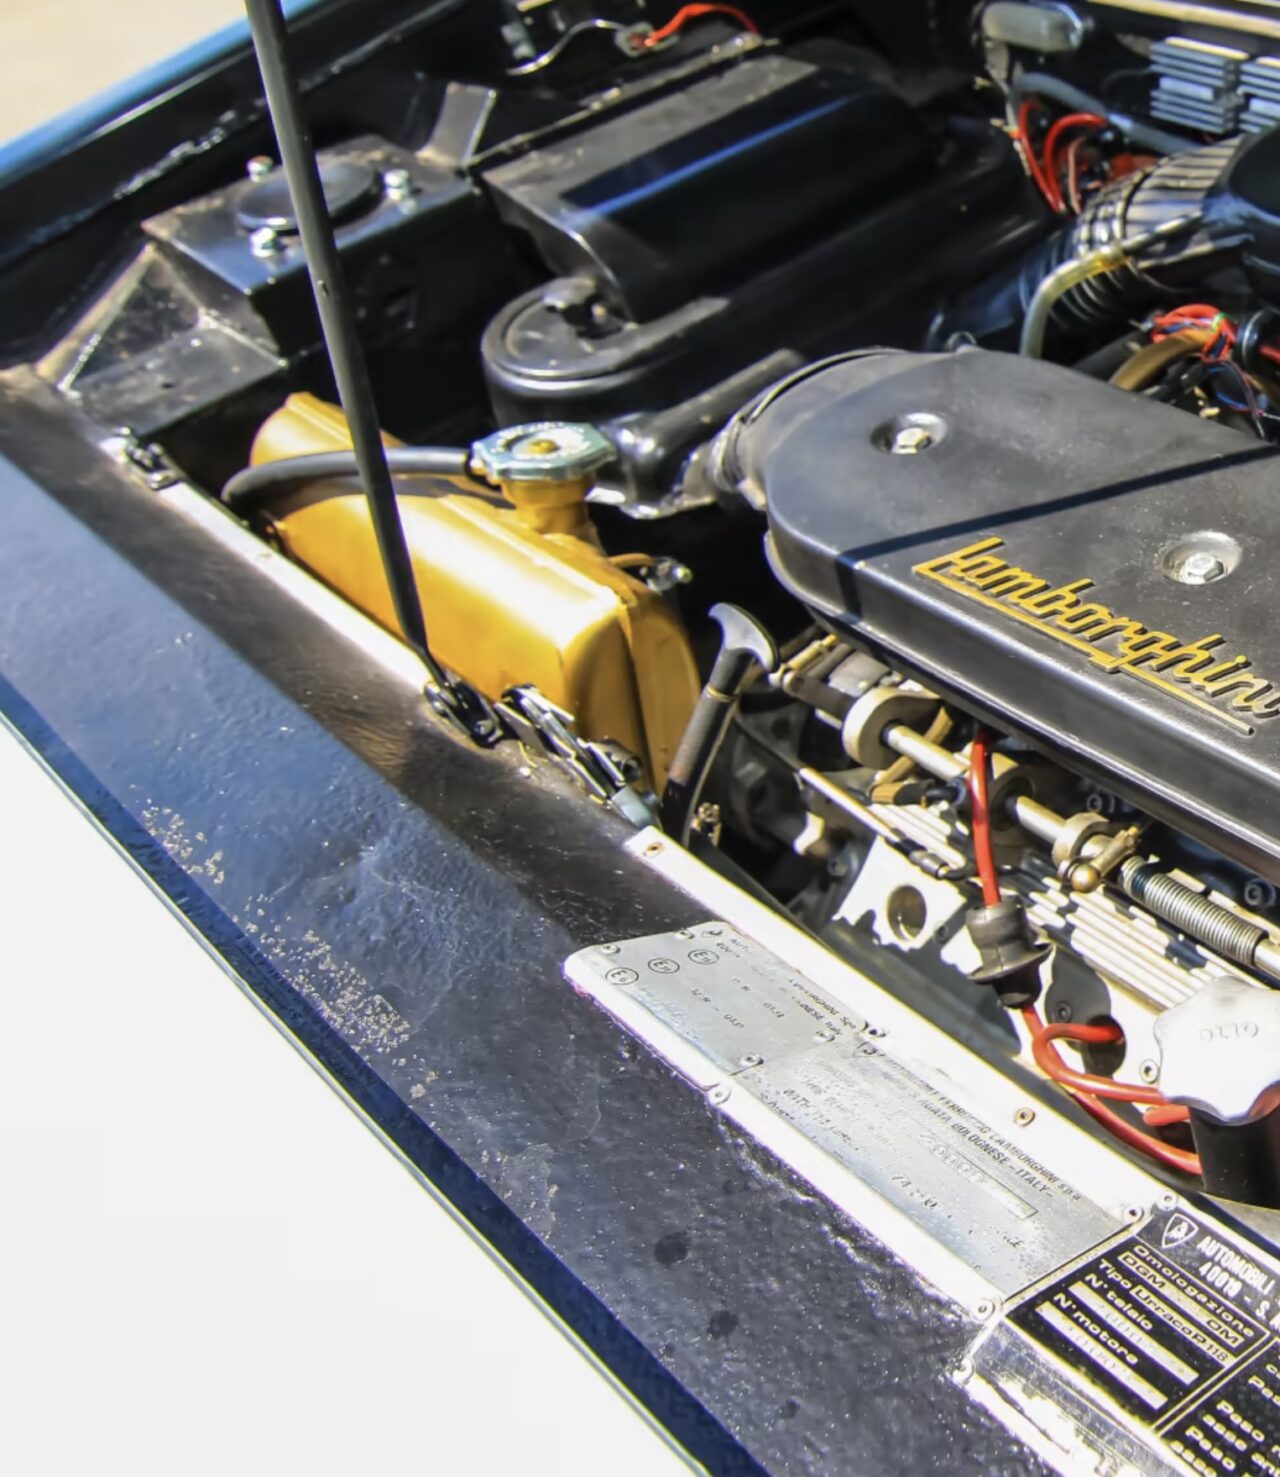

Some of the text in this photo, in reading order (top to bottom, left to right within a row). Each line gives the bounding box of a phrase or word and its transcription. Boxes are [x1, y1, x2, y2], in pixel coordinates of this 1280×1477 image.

[1199, 1020, 1260, 1042] OLIO
[950, 1122, 1012, 1165] BOLOGNESE
[989, 1132, 1061, 1184] LAMBORGHINI
[1098, 1257, 1134, 1290] Tipo
[1196, 1235, 1276, 1296] AUTOMOBILI
[1121, 1254, 1243, 1348] DGM OM
[1132, 1243, 1256, 1338] Omologazione
[1202, 1413, 1248, 1452] asse
[1215, 1399, 1266, 1443] Peso
[1184, 1424, 1237, 1472] Peso
